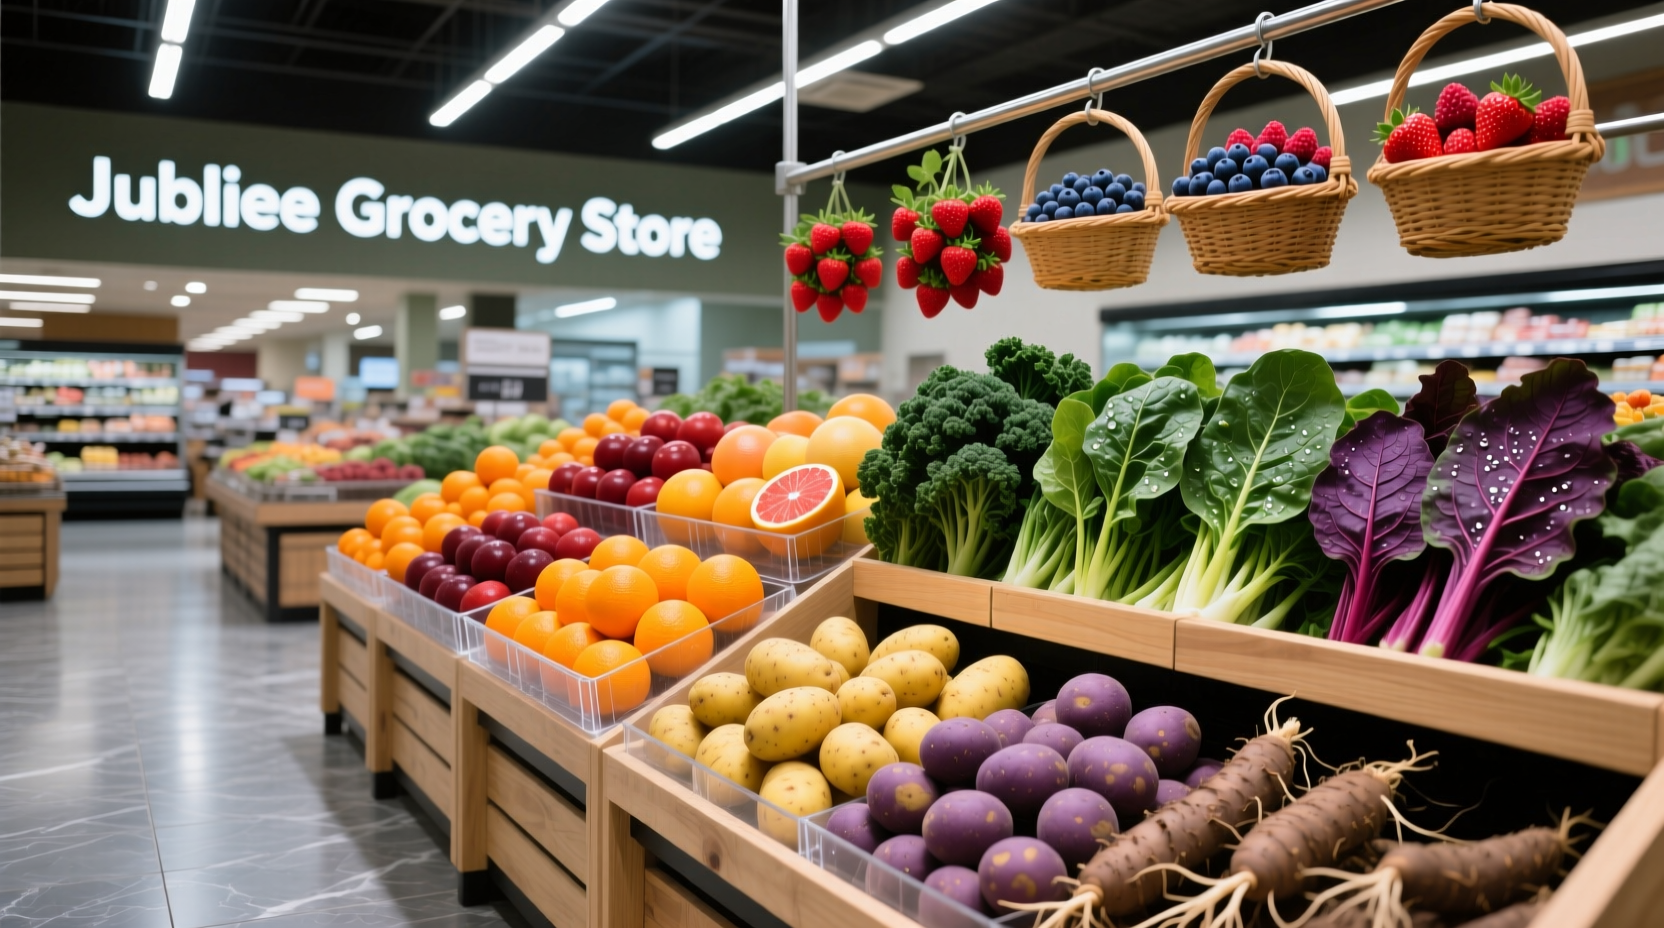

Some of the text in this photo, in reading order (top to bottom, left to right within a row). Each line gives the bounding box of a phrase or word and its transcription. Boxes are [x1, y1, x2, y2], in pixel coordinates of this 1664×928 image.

[69, 156, 723, 264] Jubliee Grocery Store
